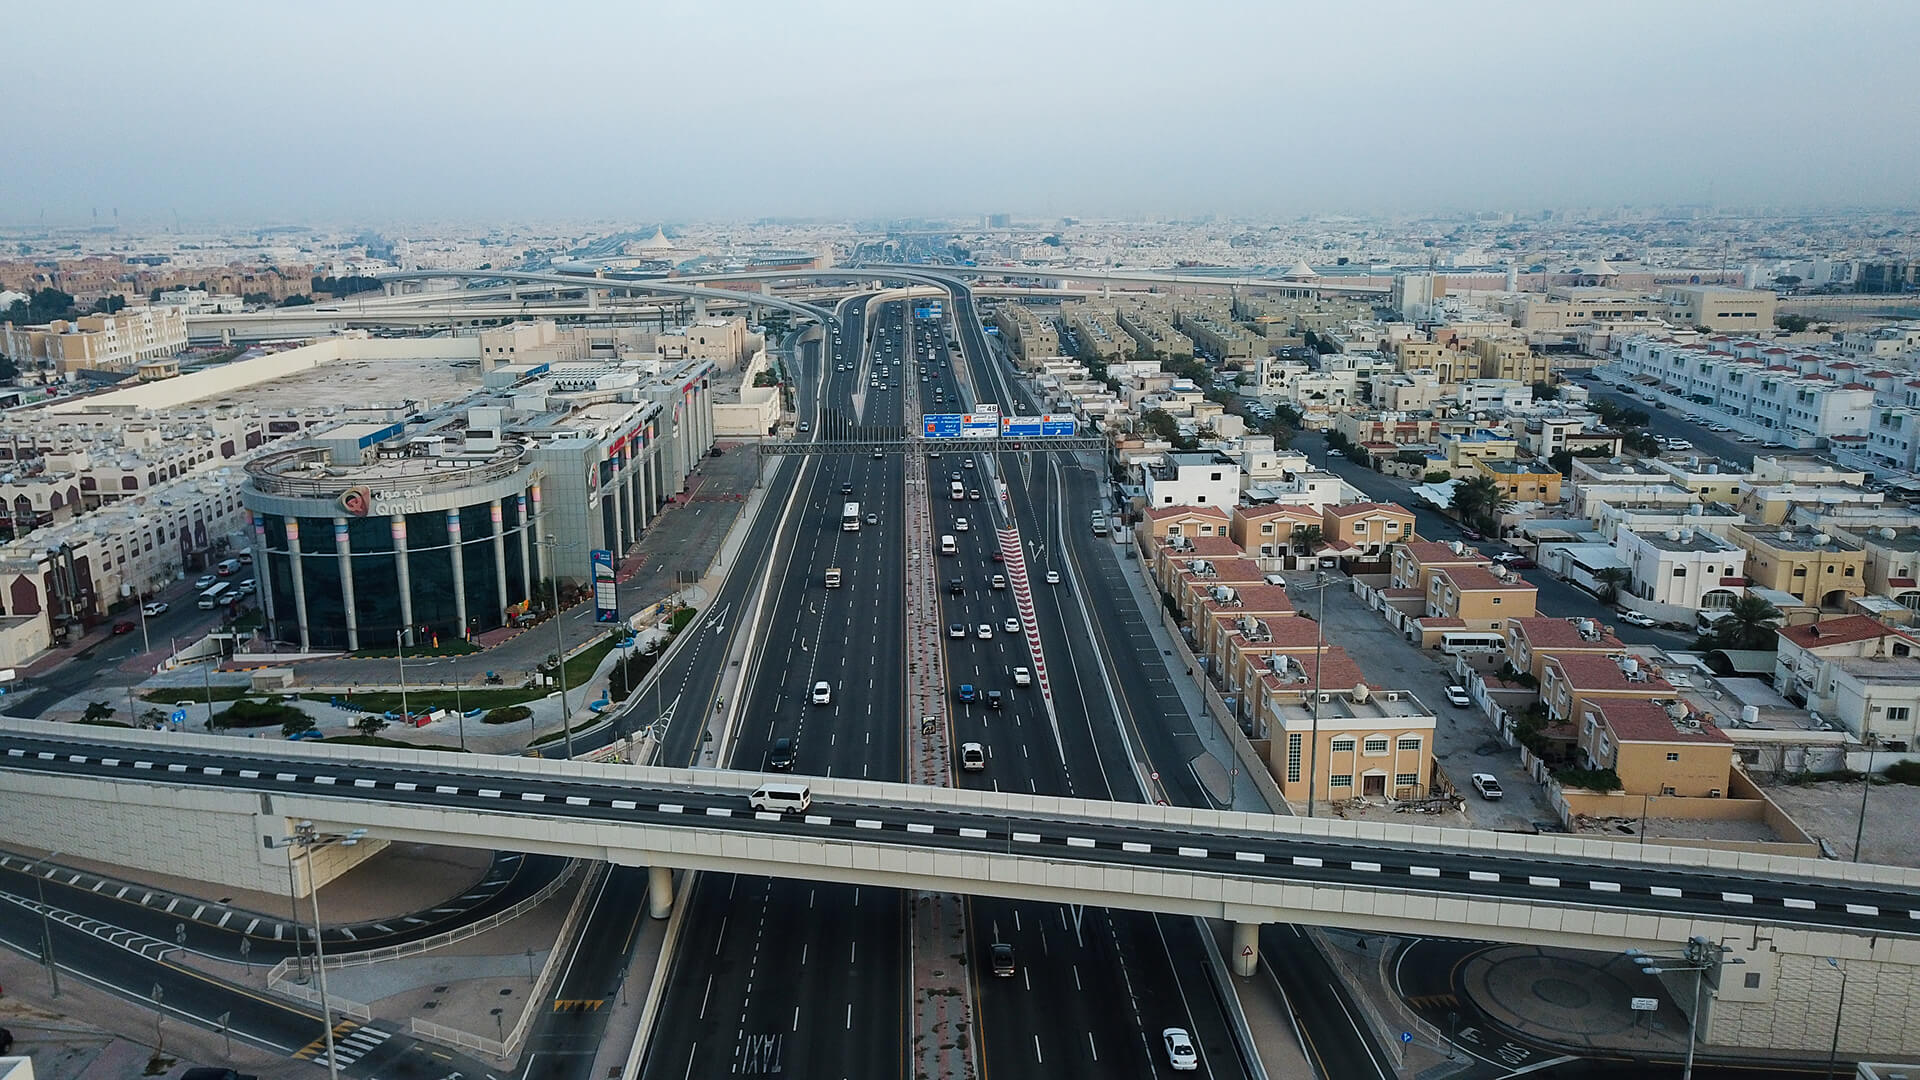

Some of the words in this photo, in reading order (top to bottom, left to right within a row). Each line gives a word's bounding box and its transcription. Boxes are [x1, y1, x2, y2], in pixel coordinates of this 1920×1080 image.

[375, 489, 401, 502] مول
[404, 485, 424, 500] كيو
[375, 498, 424, 516] Qmall
[741, 1033, 783, 1074] TAXI
[1494, 1041, 1531, 1065] STOP
